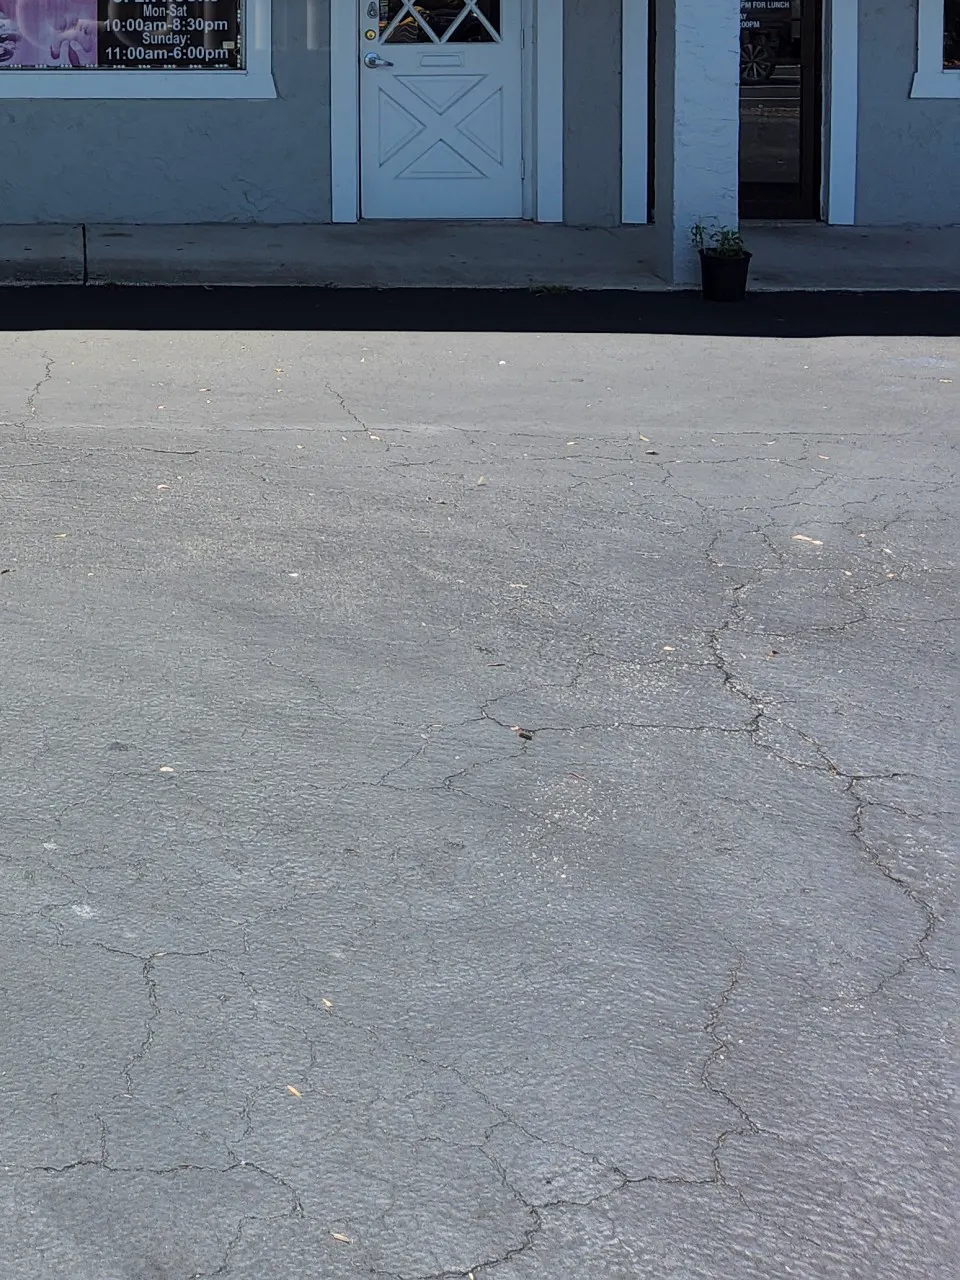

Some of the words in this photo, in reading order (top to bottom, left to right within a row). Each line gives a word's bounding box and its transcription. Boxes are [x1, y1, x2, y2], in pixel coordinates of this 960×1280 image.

[142, 4, 188, 17] Mon-Sat
[752, 1, 766, 9] FOR
[767, 1, 790, 9] LUNCH
[103, 17, 228, 34] 10:00am-8:30pm
[142, 32, 191, 47] Sunday:
[105, 46, 229, 62] 11:00am-6:00pm
